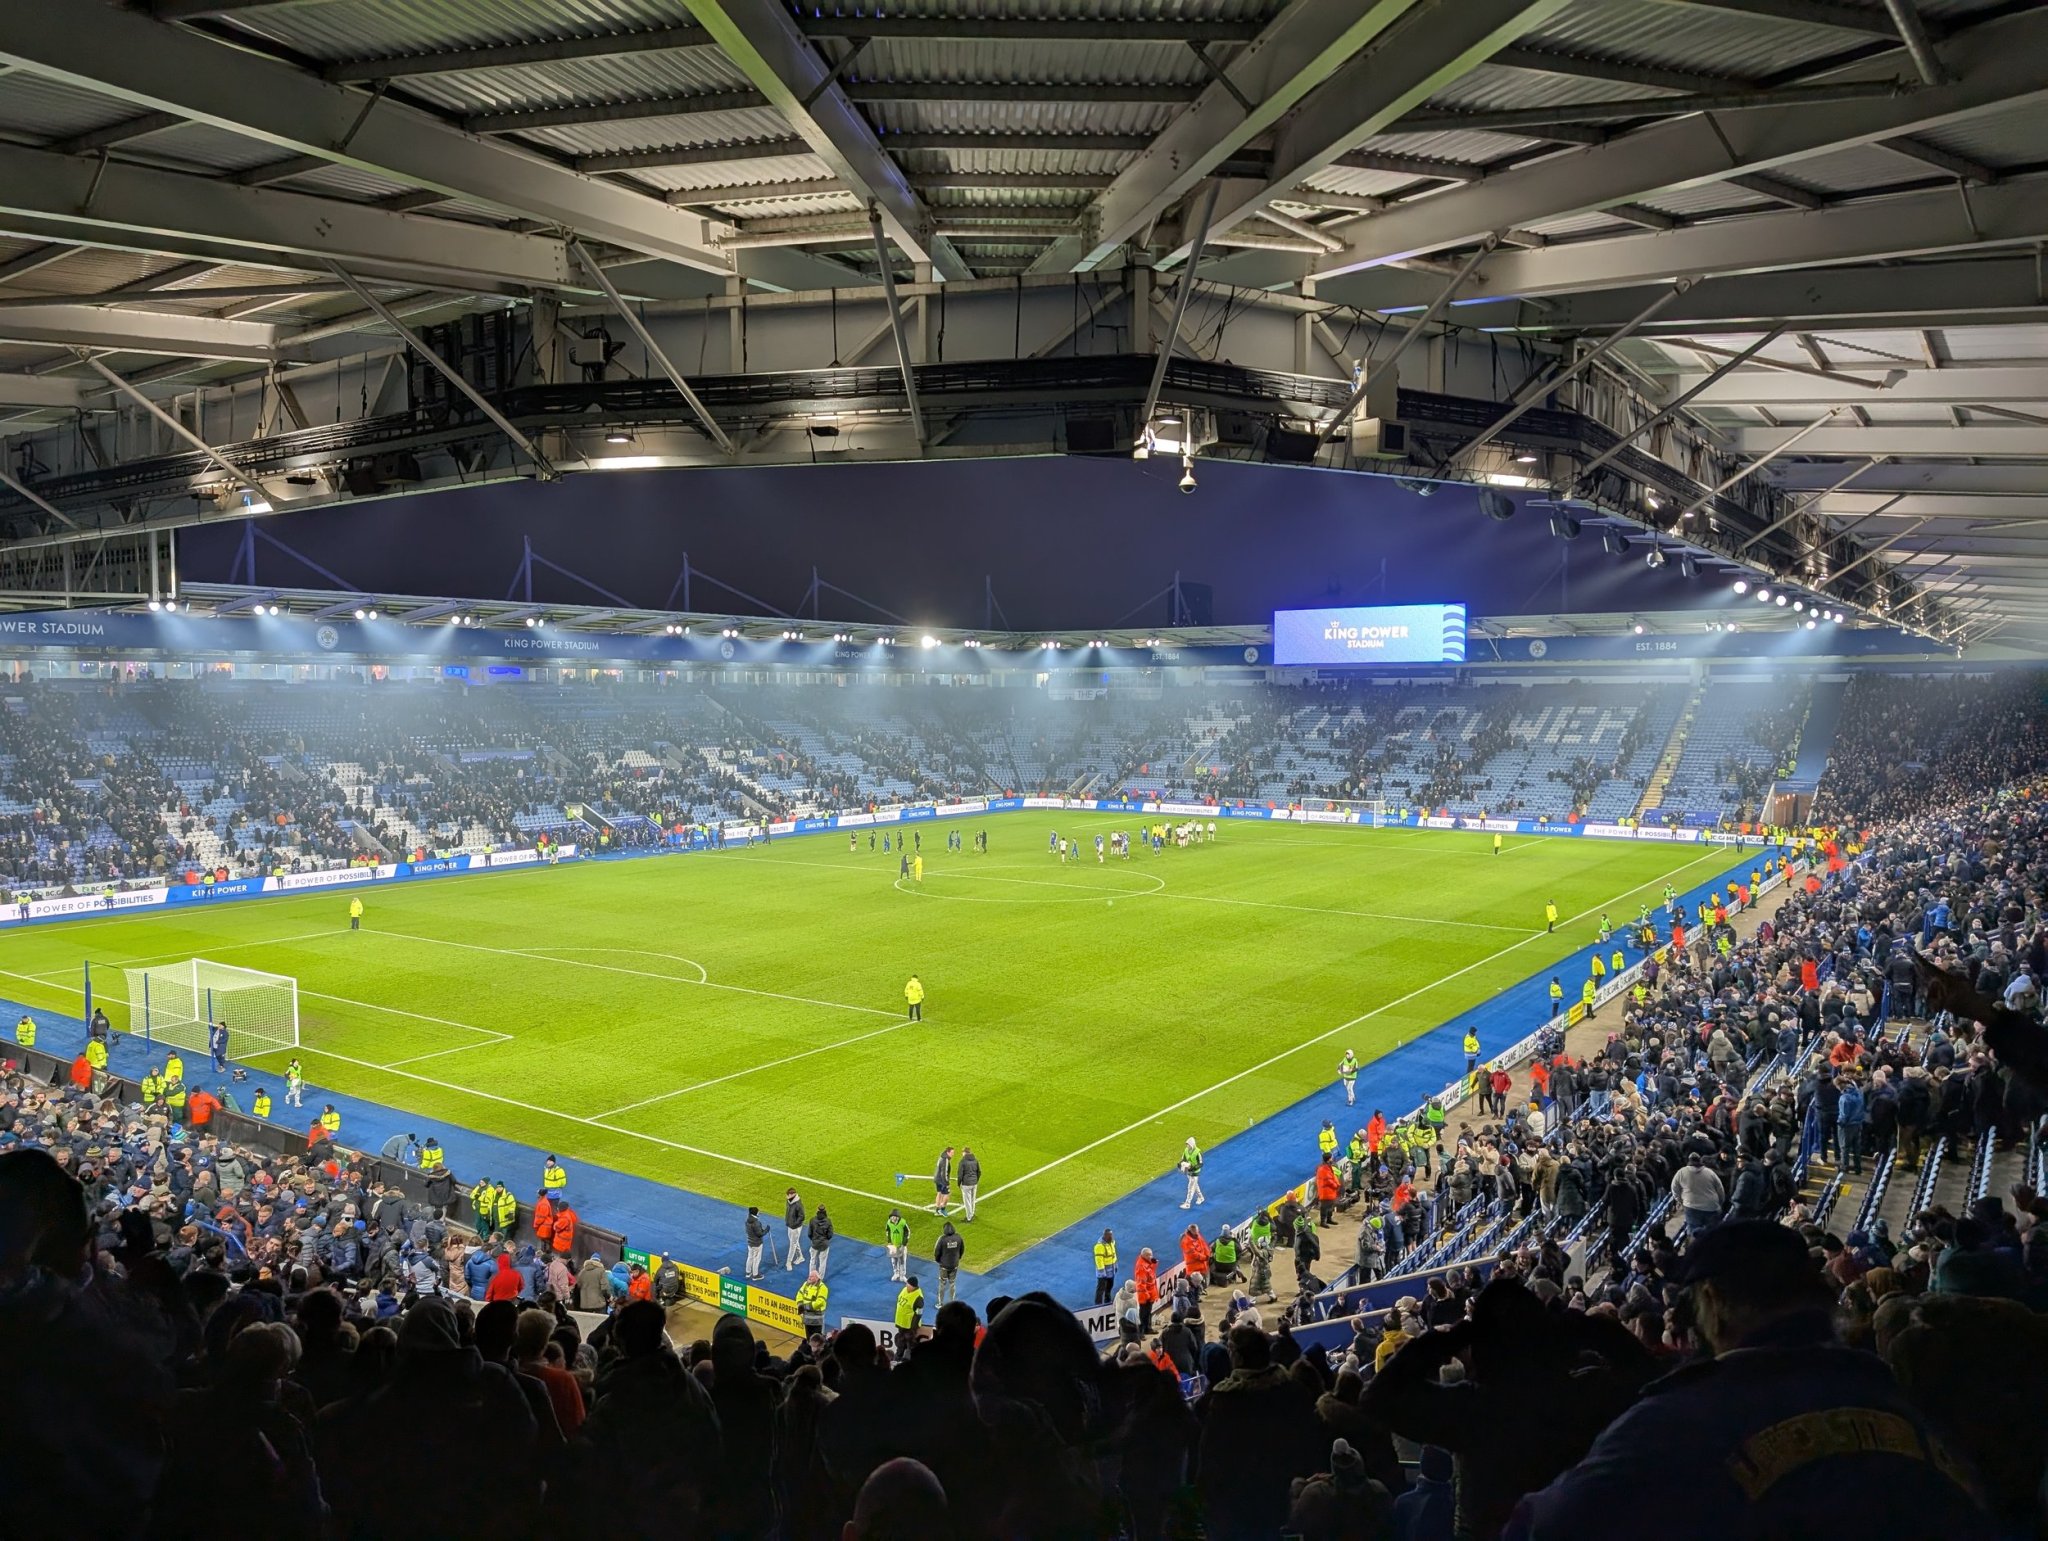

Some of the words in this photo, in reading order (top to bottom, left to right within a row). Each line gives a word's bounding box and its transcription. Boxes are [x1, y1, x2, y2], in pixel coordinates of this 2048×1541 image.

[0, 621, 37, 633] WER
[42, 622, 104, 636] STADIUM
[1324, 626, 1358, 640] KING
[1361, 625, 1409, 639] POWER
[504, 638, 529, 648] KING
[531, 639, 563, 650] POWER
[564, 640, 600, 651] STADIUM
[1347, 639, 1385, 649] STADIUM
[1655, 641, 1677, 651] 1884
[414, 864, 433, 873] KING
[295, 876, 324, 885] POWER
[339, 869, 386, 881] POSSIBILIES
[217, 885, 248, 895] POWER
[36, 903, 74, 914] POWER
[77, 901, 92, 910] OF
[94, 894, 154, 908] POSIBILITIES
[692, 1284, 704, 1294] THIS
[704, 1288, 719, 1298] POINT
[724, 1282, 733, 1290] LIFT
[733, 1285, 743, 1293] OFF
[727, 1291, 738, 1300] CASE
[720, 1297, 746, 1311] EMERGENCY
[758, 1295, 764, 1304] IT
[764, 1297, 770, 1306] IS
[770, 1300, 778, 1308] AN
[779, 1302, 798, 1315] ARREST
[748, 1303, 771, 1318] OFFENCE
[771, 1311, 779, 1320] TO
[779, 1314, 792, 1326] PASS
[792, 1318, 805, 1330] THIS
